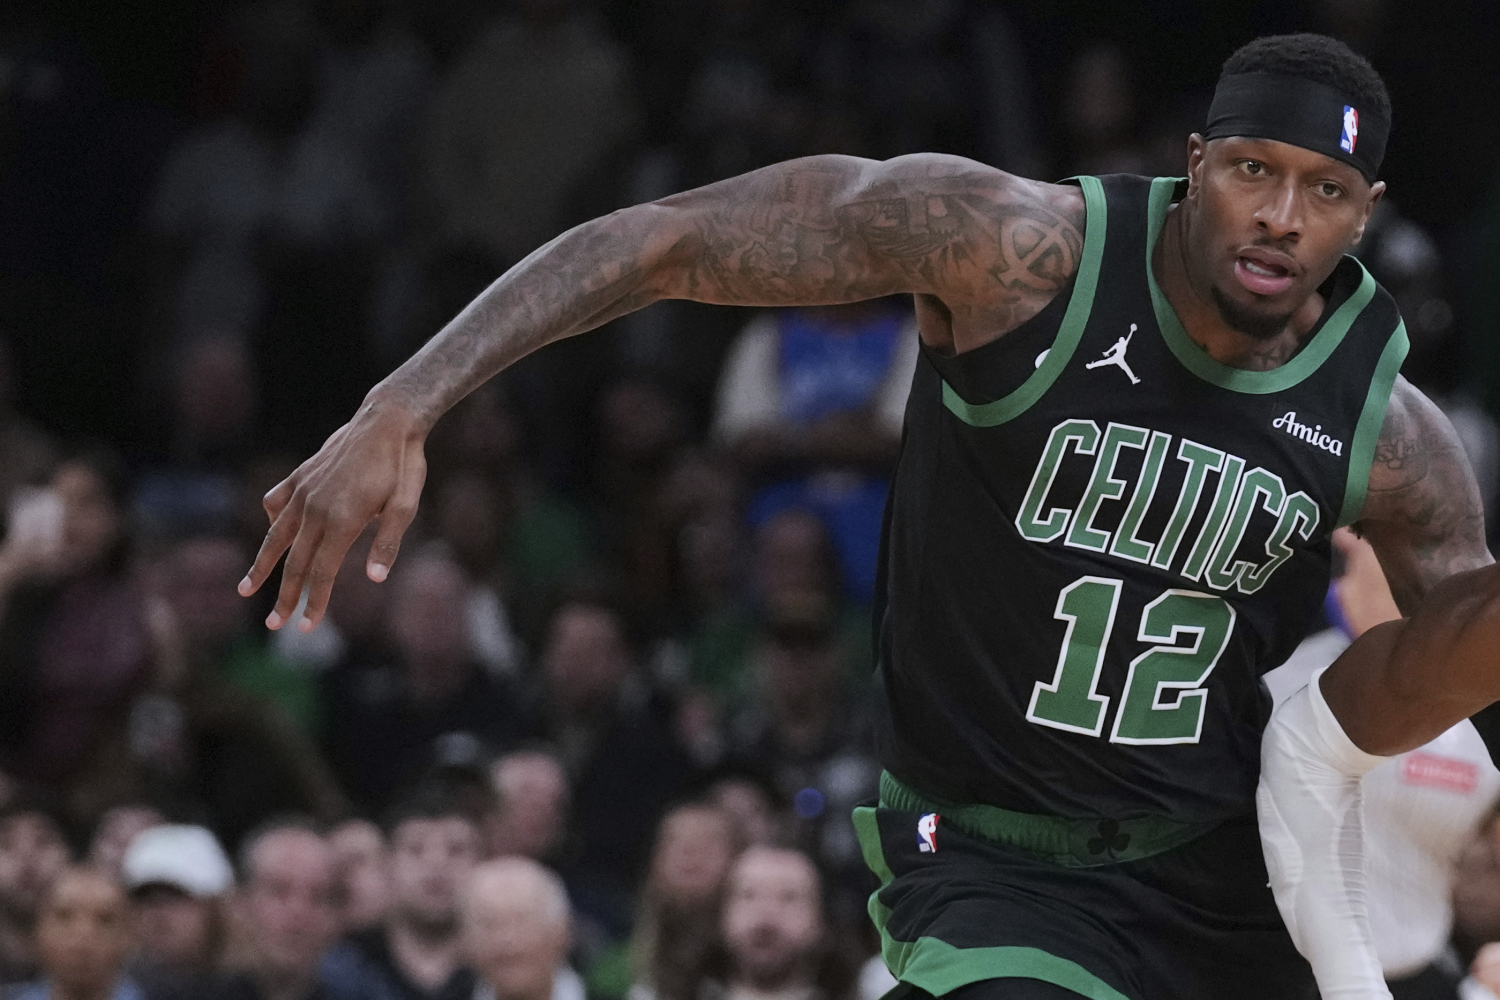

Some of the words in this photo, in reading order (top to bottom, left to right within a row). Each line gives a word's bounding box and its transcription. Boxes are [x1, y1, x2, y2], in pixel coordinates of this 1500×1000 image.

[1016, 418, 1320, 596] CELTICS
[1272, 411, 1343, 457] Amica
[1026, 575, 1237, 746] 12
